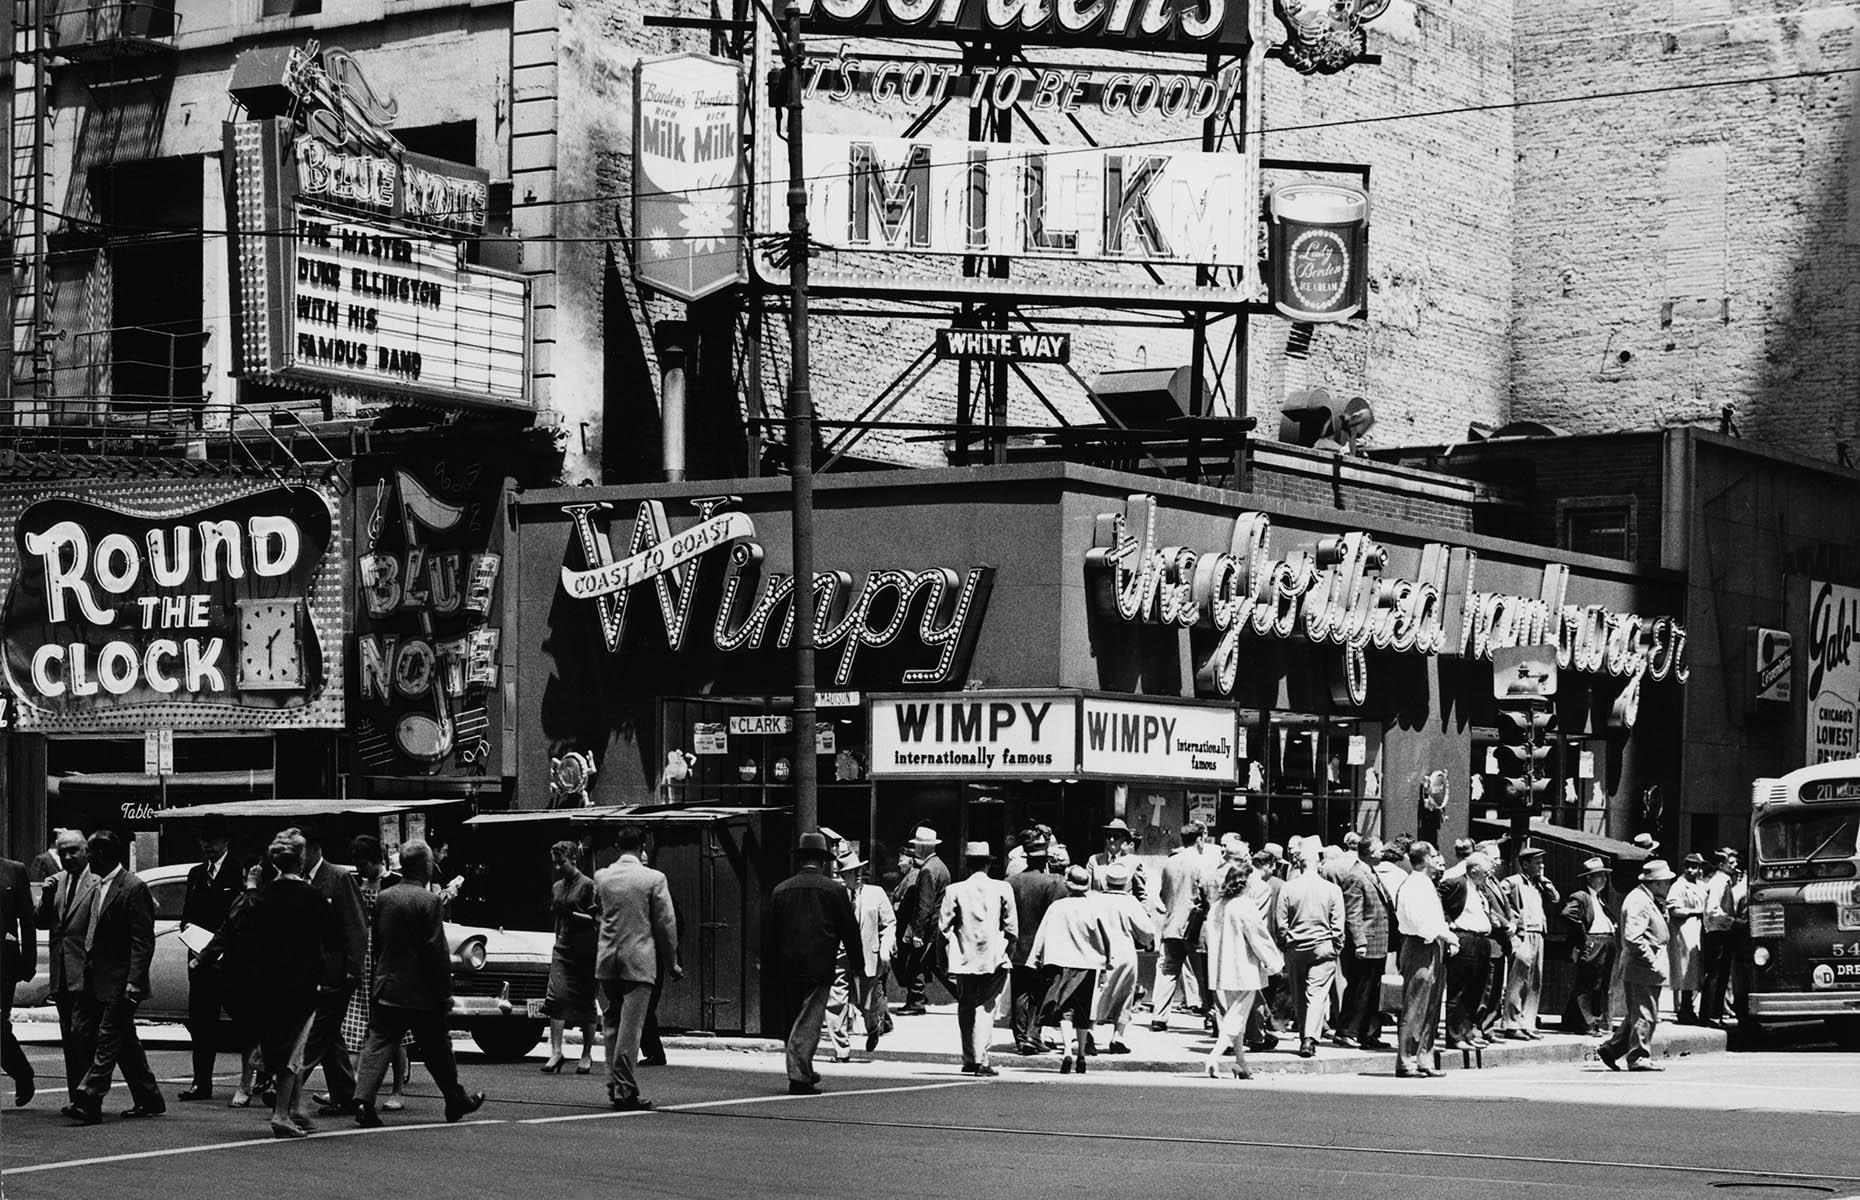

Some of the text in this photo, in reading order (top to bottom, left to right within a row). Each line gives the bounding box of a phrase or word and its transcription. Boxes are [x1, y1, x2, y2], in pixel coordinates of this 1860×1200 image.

[803, 43, 1241, 121] T'S GOT TO BE GOOD!
[655, 106, 678, 119] RICH
[706, 111, 727, 121] RICH
[643, 115, 687, 163] Milk
[694, 123, 736, 163] Milk
[295, 133, 488, 227] BLUE NOTE
[848, 141, 1176, 258] MILK
[298, 219, 413, 263] THE MASTER
[1298, 240, 1334, 266] Lady
[298, 256, 442, 309] DUKE ELLINGTON
[1296, 262, 1342, 279] Borden
[297, 294, 377, 332] WITH HIS
[298, 333, 422, 380] FAMOUS BAND
[946, 332, 1065, 357] WHITE WAY
[574, 515, 735, 594] COAST TO COAST
[359, 548, 501, 618] BLUE
[561, 495, 997, 687] Wimpy
[137, 594, 212, 630] THE
[1086, 494, 1690, 728] the glorified hamburger
[31, 637, 226, 698] CLOCK
[359, 623, 501, 705] NOTE
[738, 717, 781, 733] CLARK
[895, 702, 1053, 744] WIMPY
[1087, 711, 1177, 756] WIMPY
[1818, 707, 1853, 723] CHICAGO'S
[1176, 737, 1232, 760] internationally
[1816, 725, 1854, 747] LOWEST
[895, 747, 1053, 769] internationally famous
[1191, 754, 1218, 772] famous
[1817, 784, 1833, 800] 20
